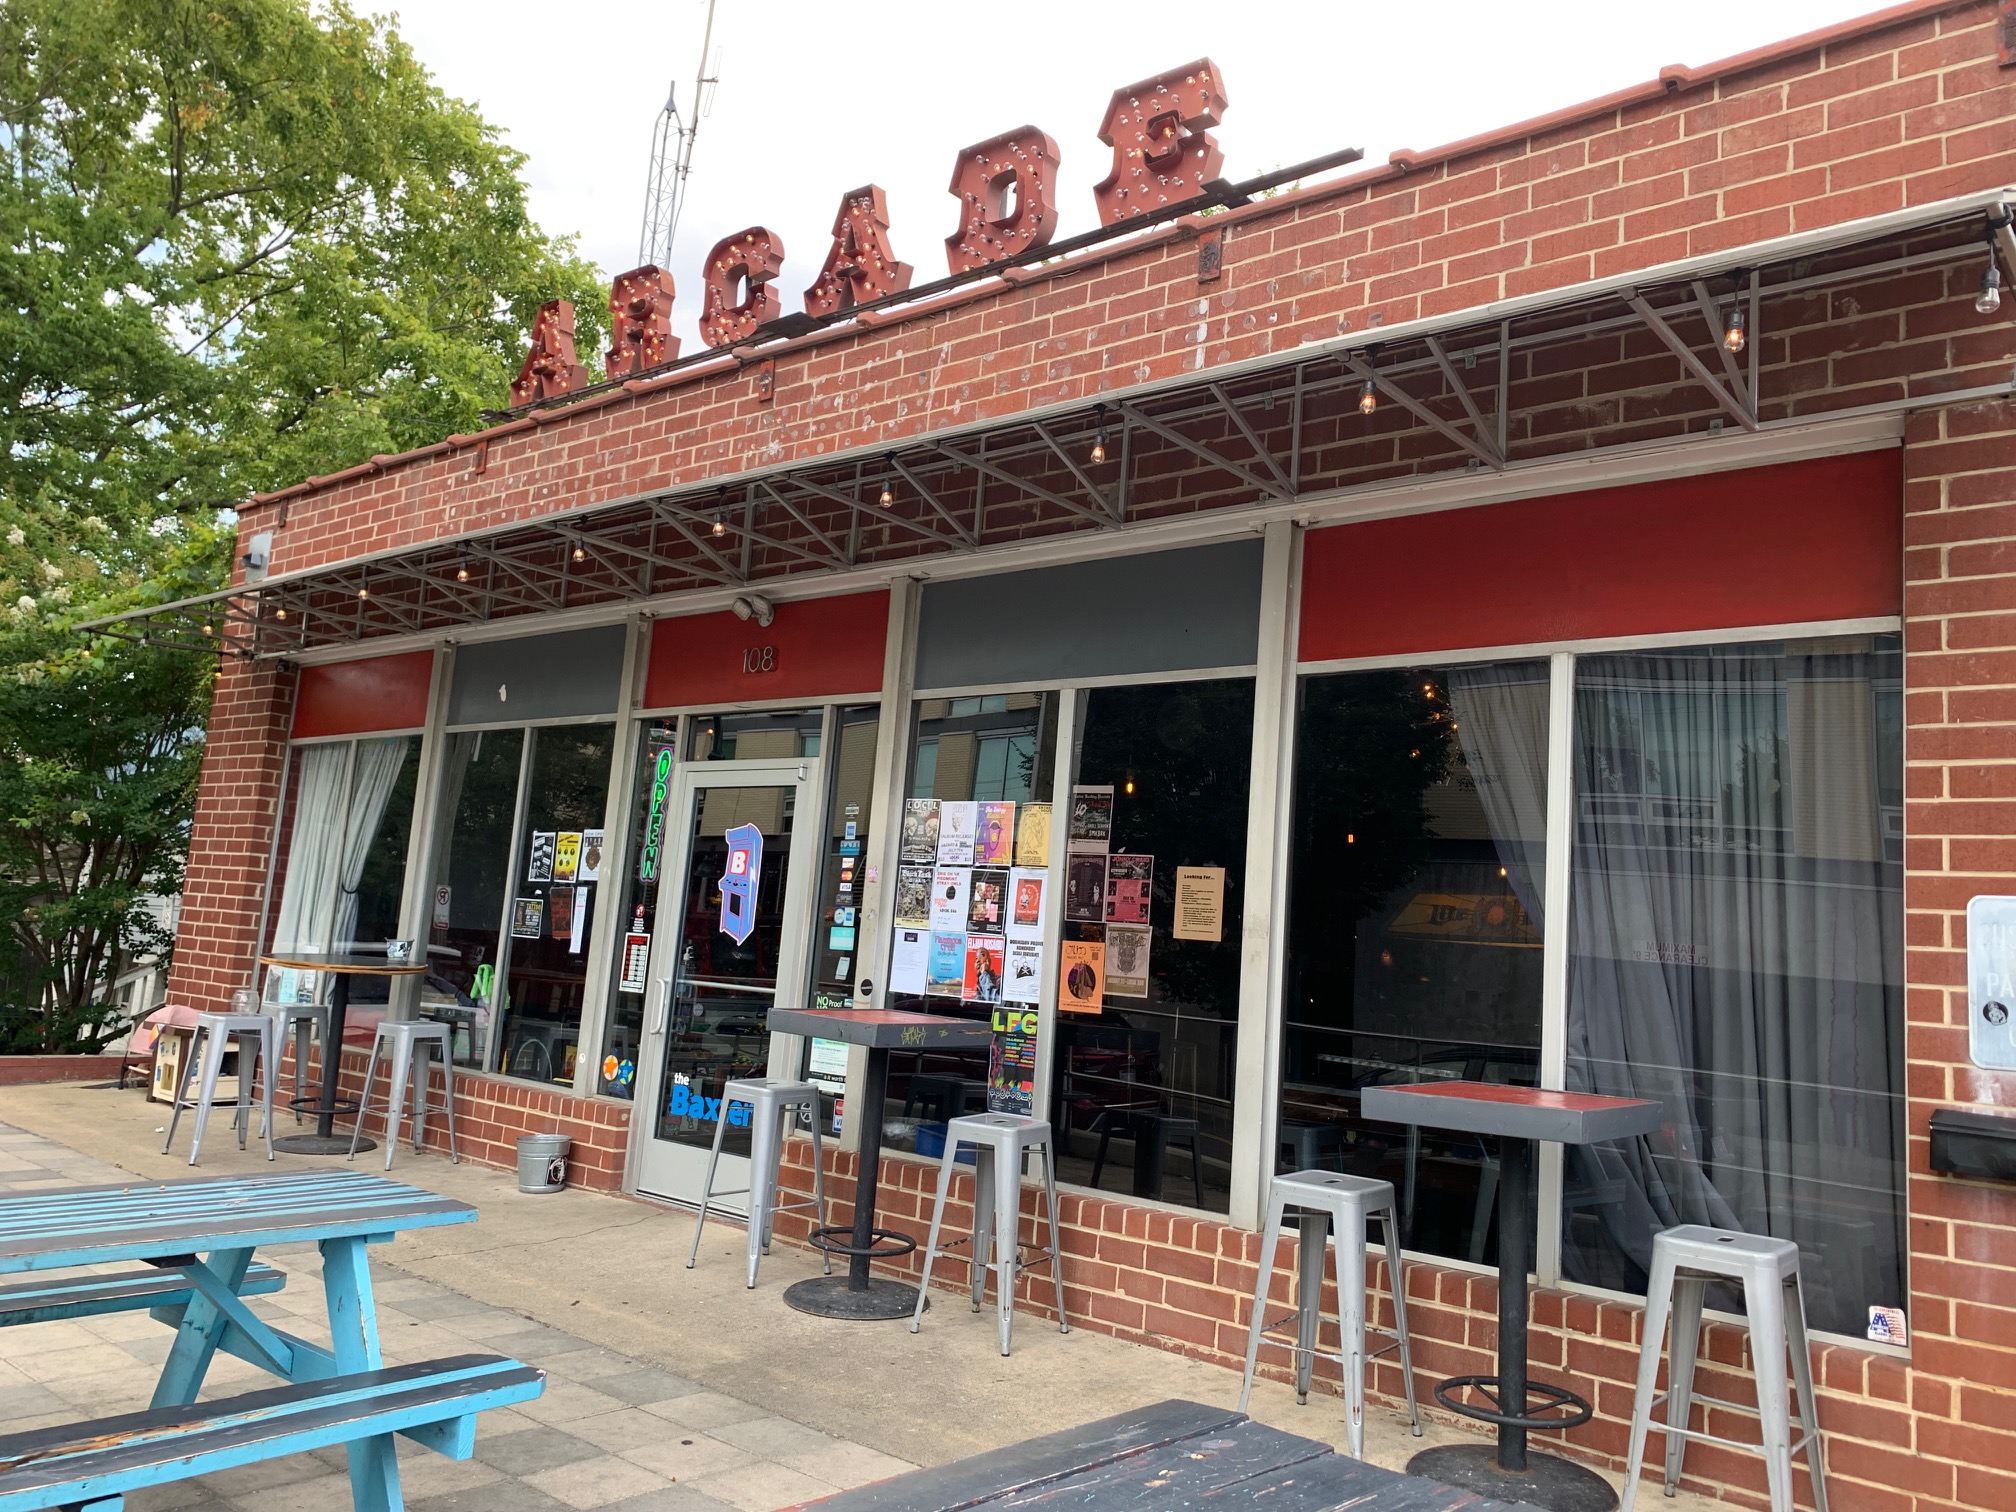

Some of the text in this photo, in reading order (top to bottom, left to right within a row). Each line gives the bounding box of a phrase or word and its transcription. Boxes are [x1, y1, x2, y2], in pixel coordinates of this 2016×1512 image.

[511, 57, 1228, 406] ARCADE
[743, 646, 773, 674] 108
[641, 749, 672, 879] OPEN
[730, 851, 746, 874] B
[816, 996, 843, 1008] NO Proof
[993, 1011, 1038, 1034] LFG
[674, 1072, 690, 1086] the
[670, 1084, 754, 1127] Baxer
